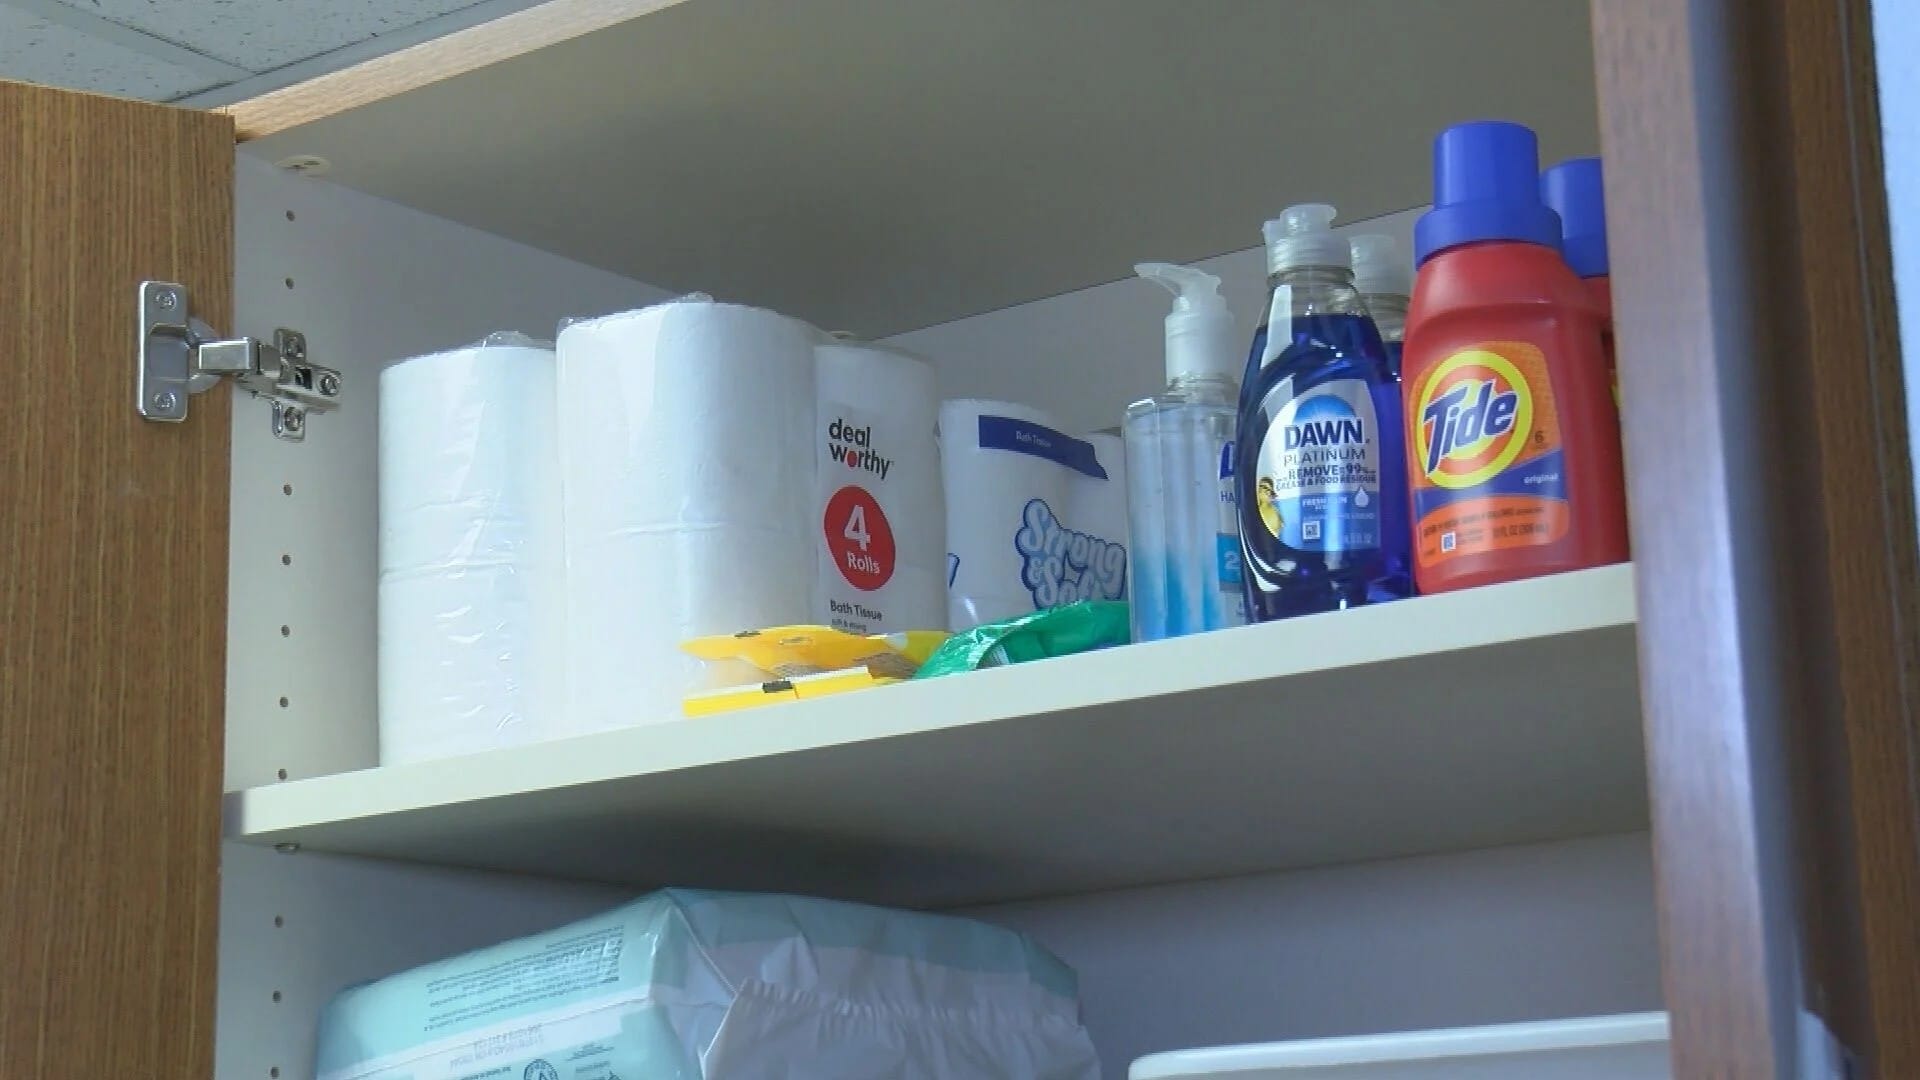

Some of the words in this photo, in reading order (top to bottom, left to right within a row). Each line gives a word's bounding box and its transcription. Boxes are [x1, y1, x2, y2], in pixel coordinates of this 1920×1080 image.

[828, 418, 871, 448] deal
[1284, 419, 1363, 450] DAWN
[1422, 377, 1519, 479] Tide
[1534, 430, 1545, 444] 6
[828, 442, 890, 481] worthy
[1283, 447, 1366, 467] PLATINUM
[1315, 475, 1339, 487] FOOD
[1523, 472, 1558, 484] original
[843, 504, 872, 551] 4
[846, 551, 881, 575] Rolls
[1015, 498, 1127, 601] Strong
[829, 598, 854, 616] Bath
[853, 603, 883, 622] Tissue
